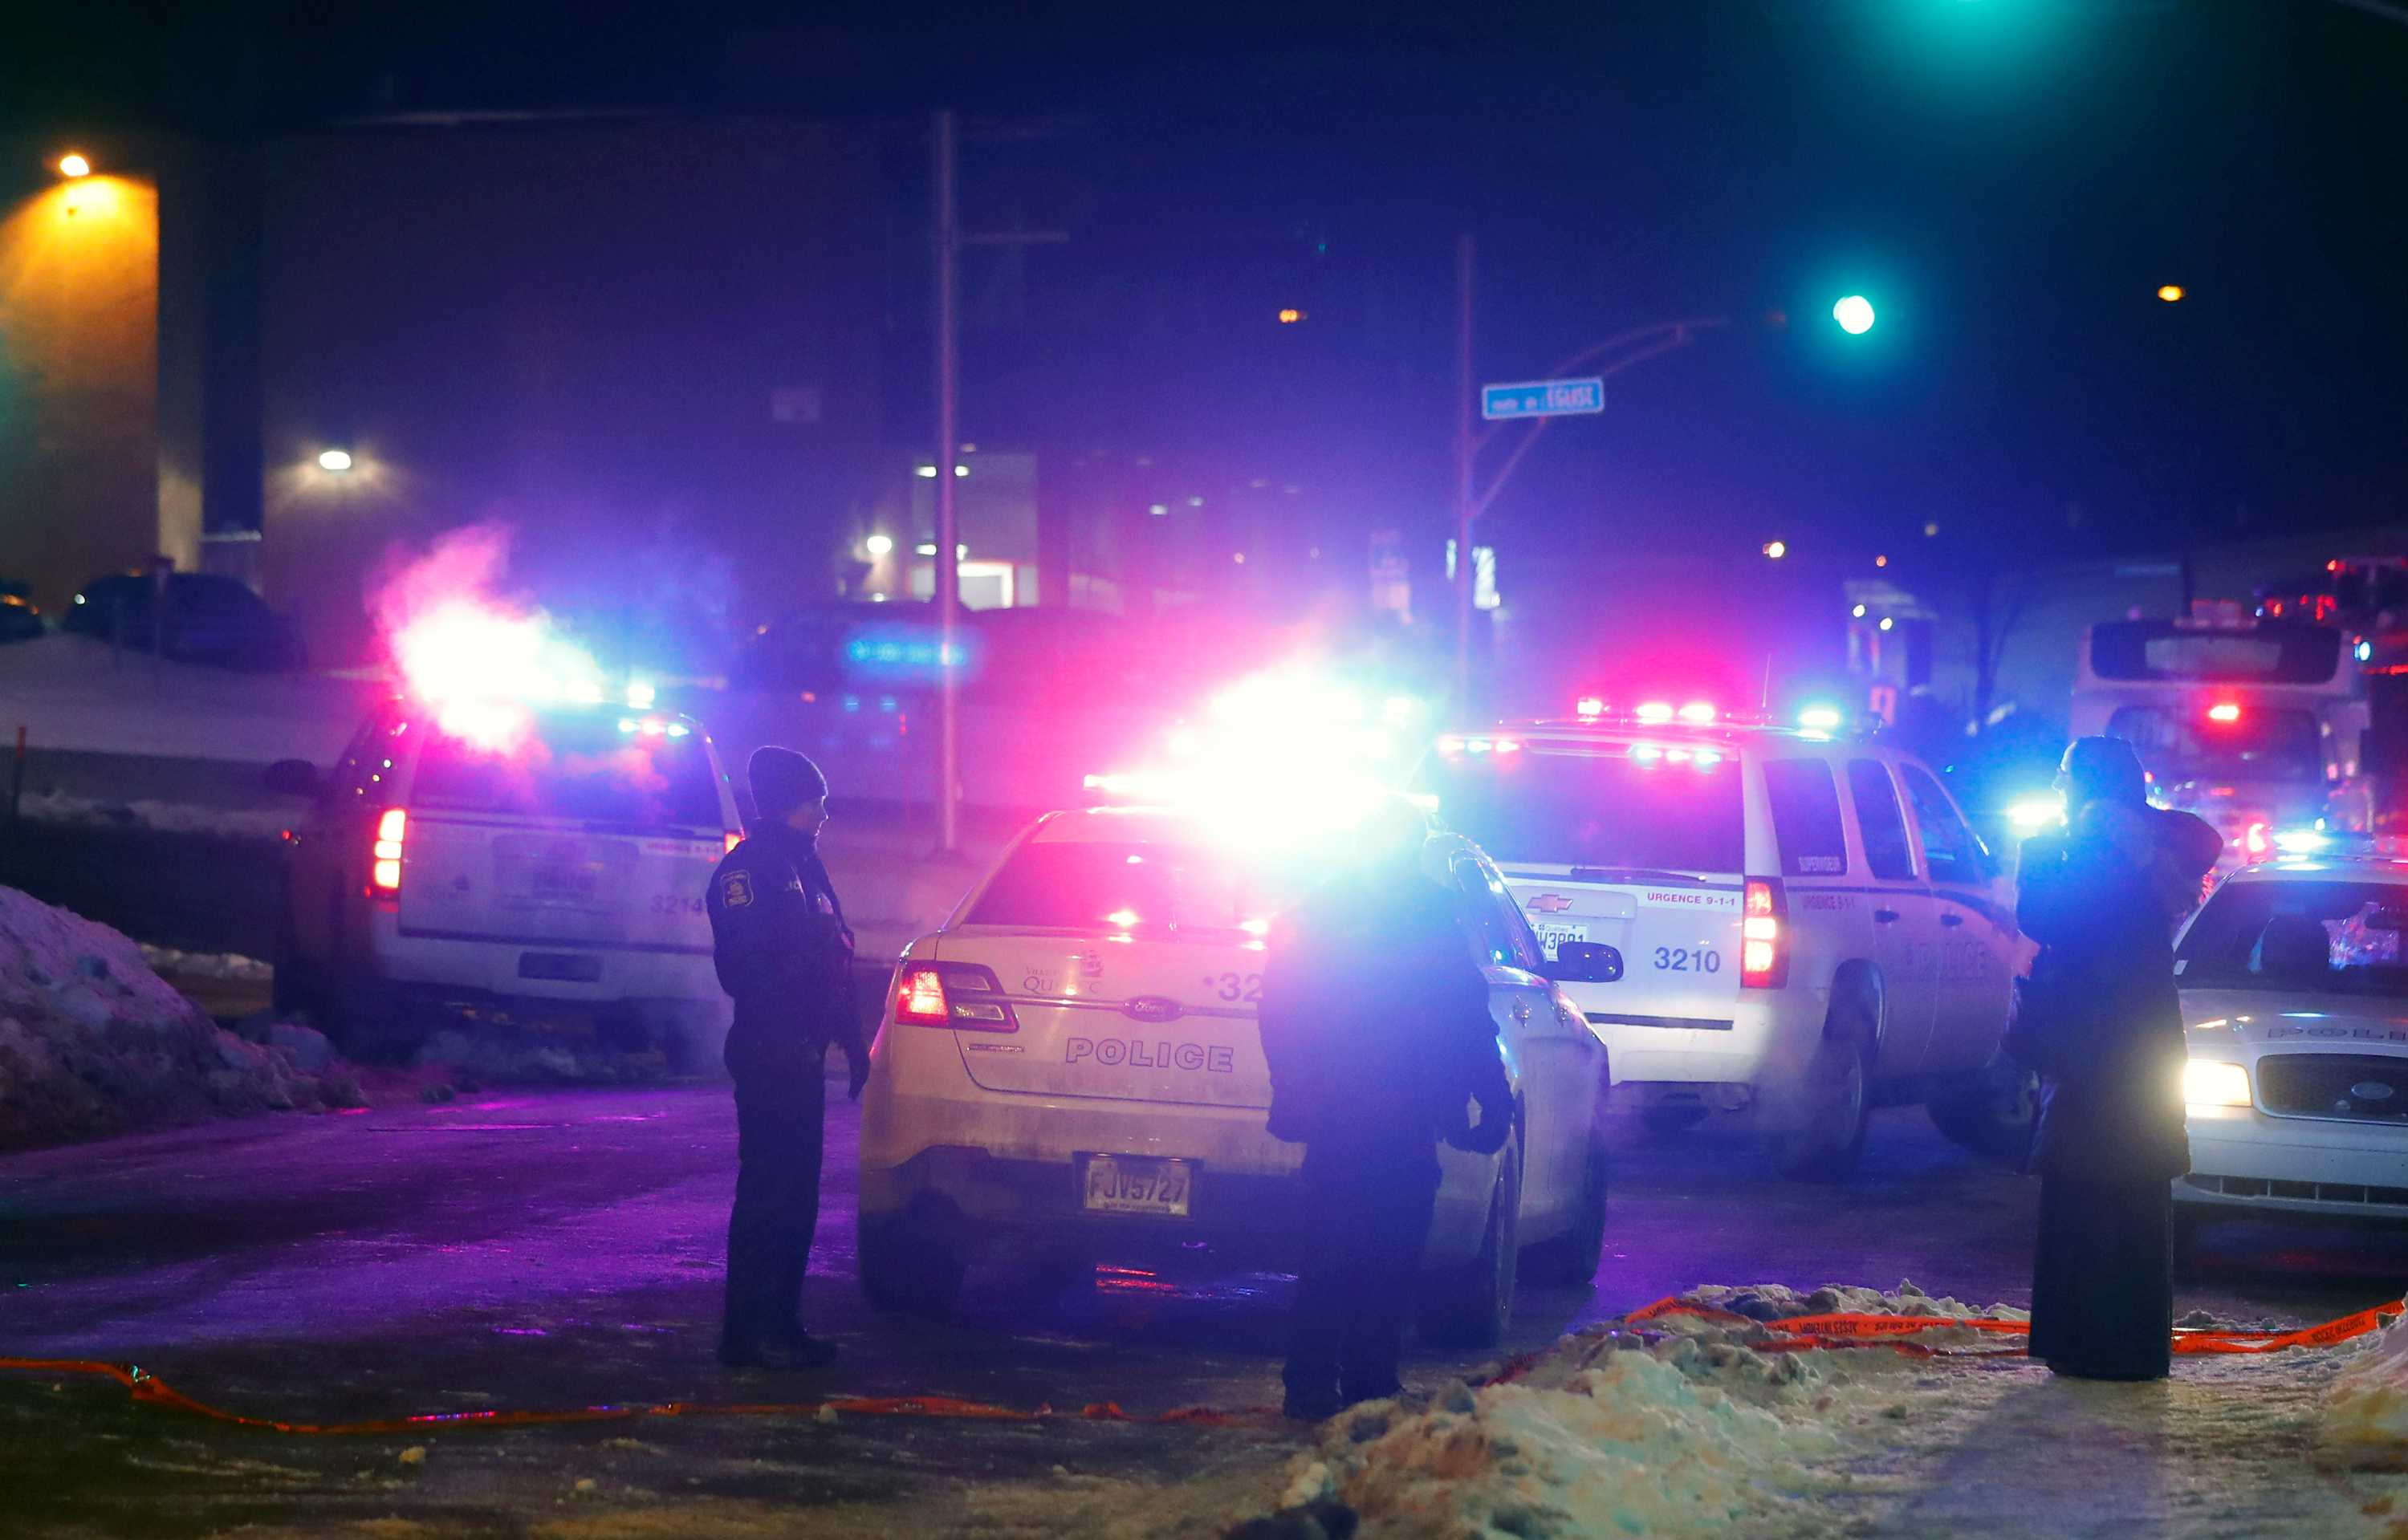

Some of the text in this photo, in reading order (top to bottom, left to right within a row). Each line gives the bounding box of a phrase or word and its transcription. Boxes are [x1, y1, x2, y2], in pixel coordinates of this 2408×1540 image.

[1647, 892, 1735, 906] URGENCE 9-1-1
[1653, 946, 1721, 973] 3210
[1065, 1038, 1235, 1073] POLICE
